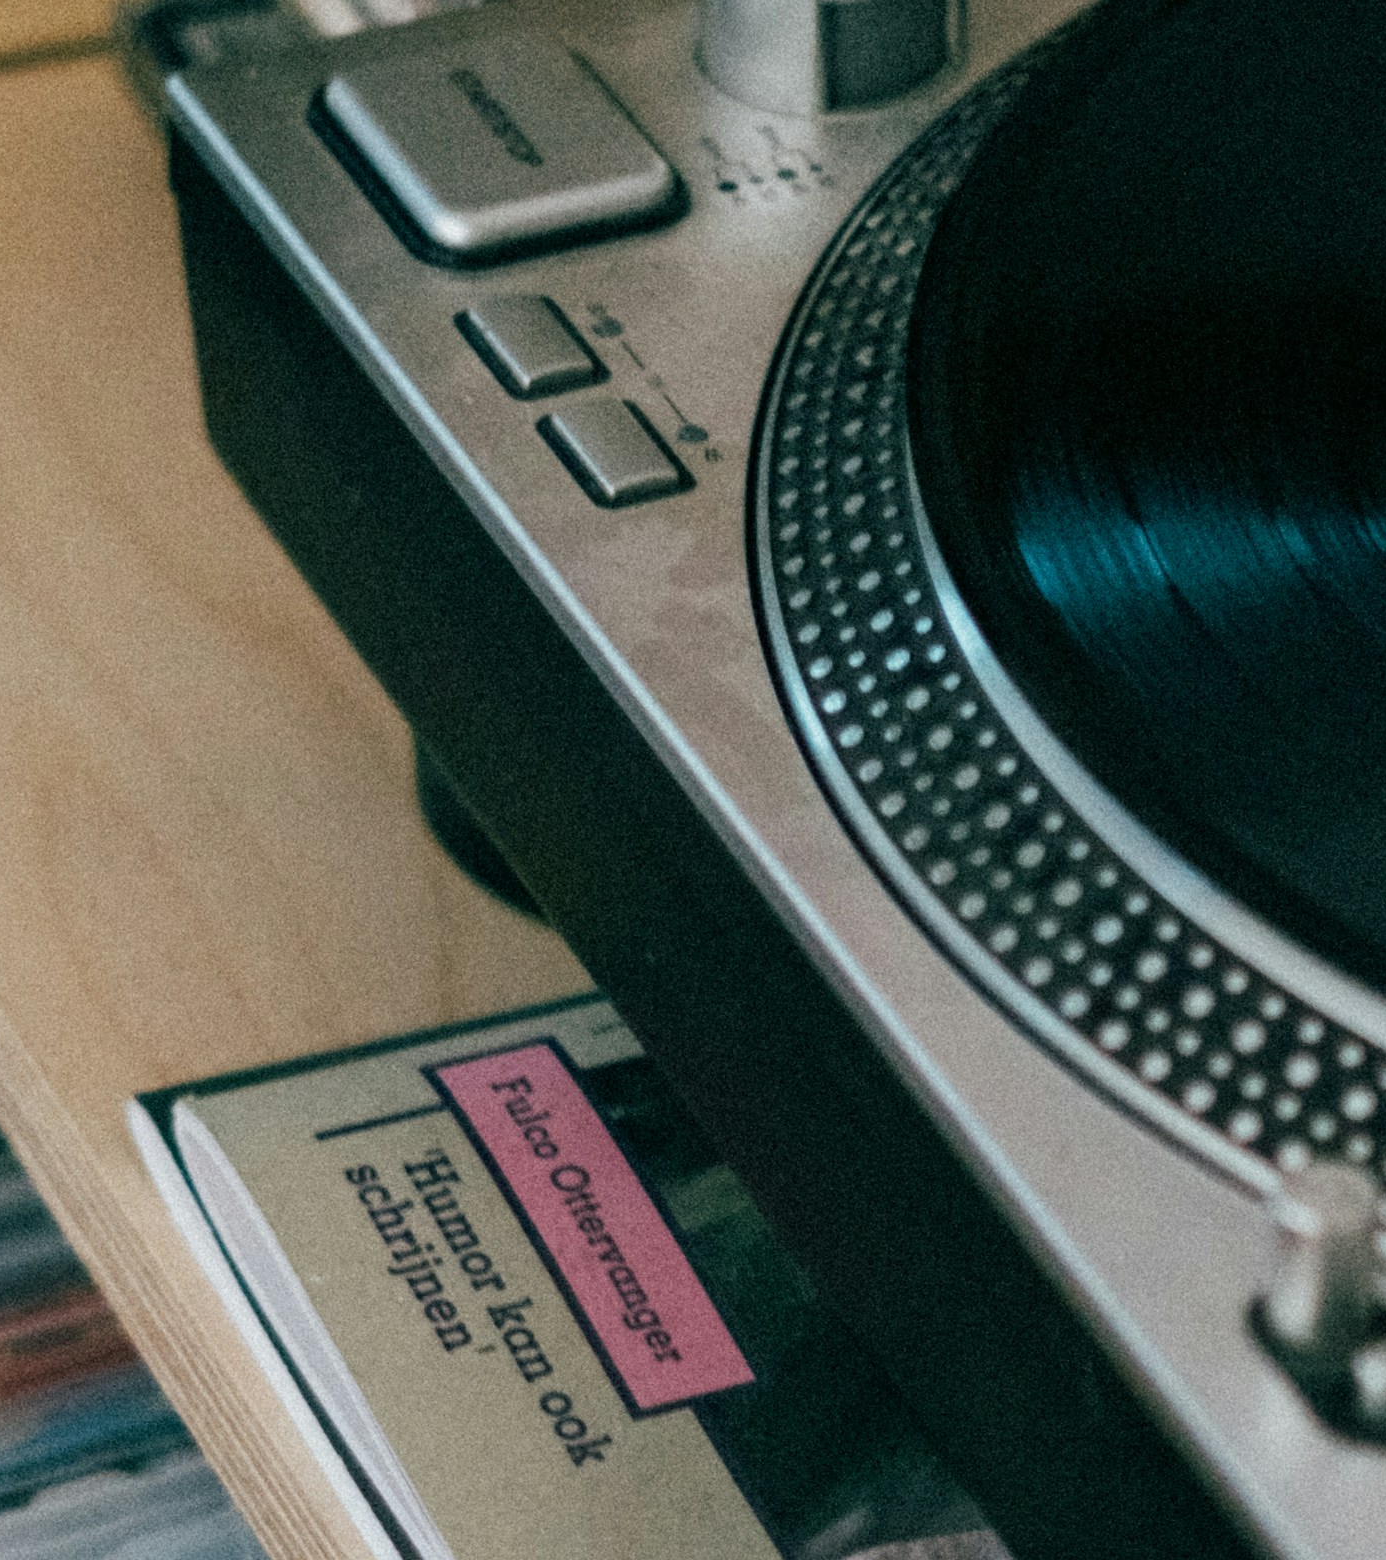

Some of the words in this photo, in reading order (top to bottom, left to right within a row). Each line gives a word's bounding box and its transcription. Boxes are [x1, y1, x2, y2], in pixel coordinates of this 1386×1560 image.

[490, 1073, 559, 1159] Fulco
[550, 1164, 682, 1365] Ottervanger
[488, 1296, 553, 1383] kan
[540, 1390, 613, 1467] ook
